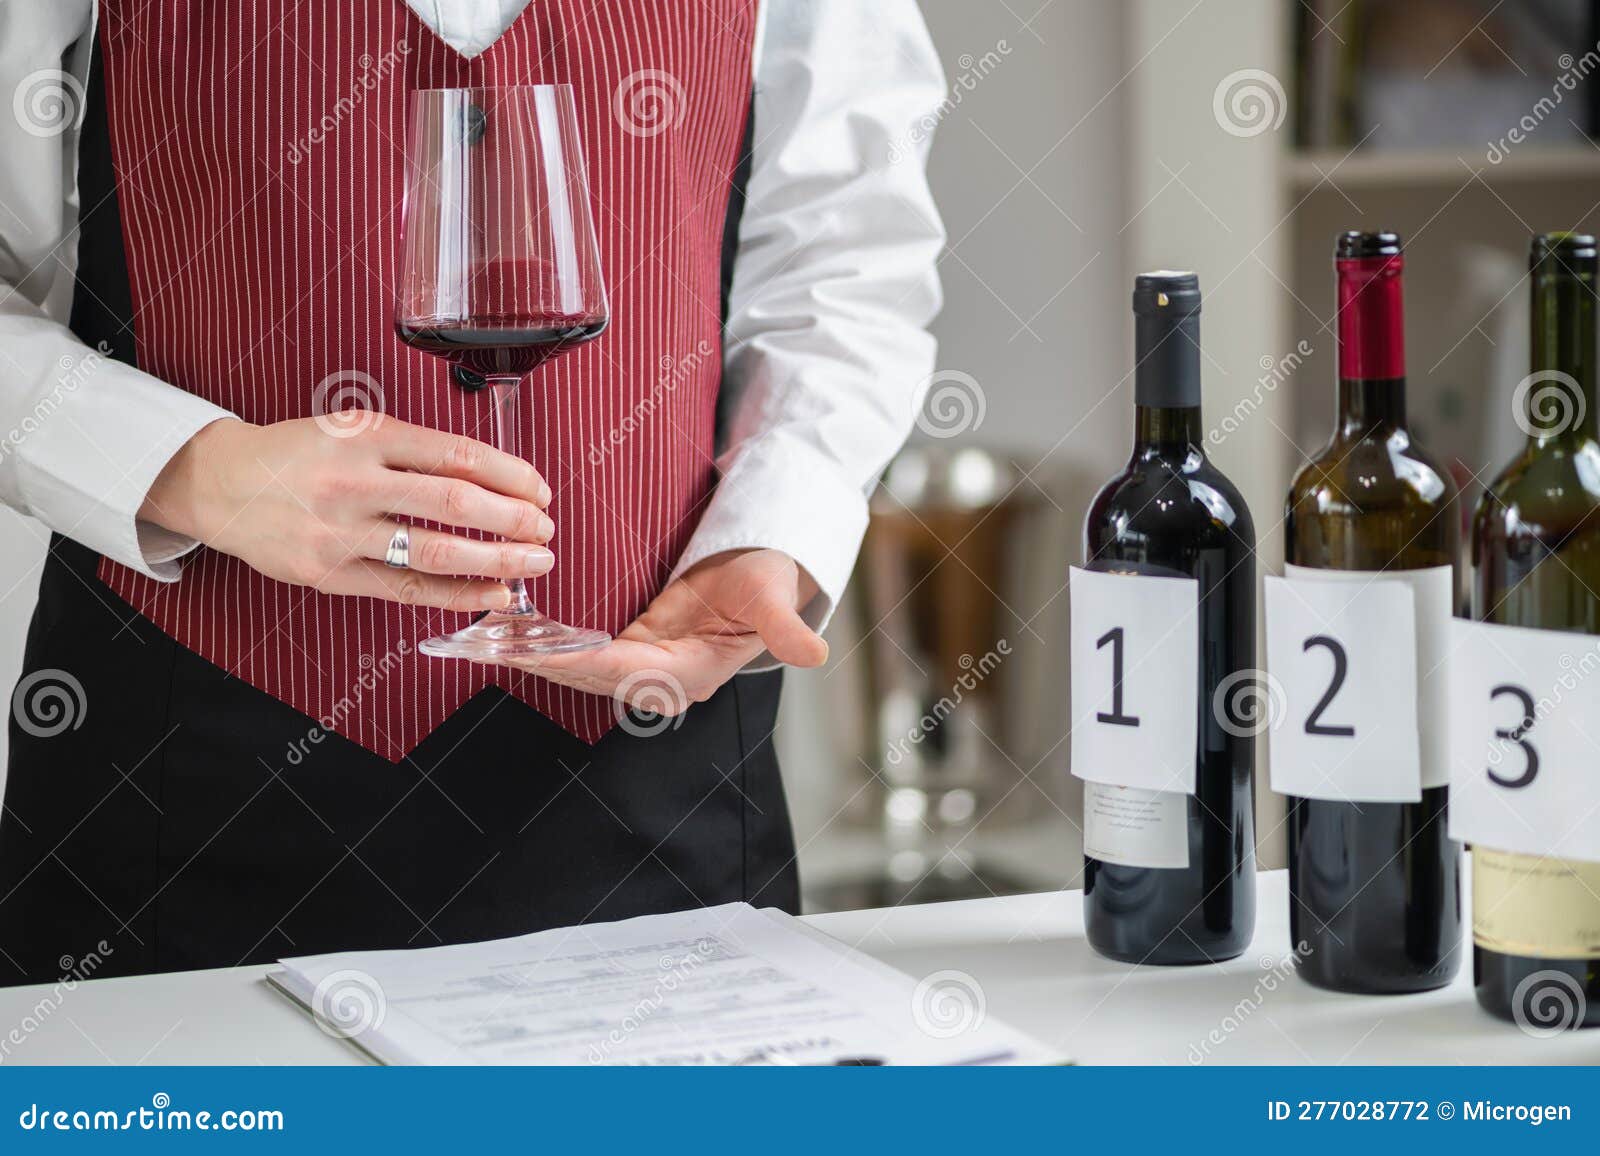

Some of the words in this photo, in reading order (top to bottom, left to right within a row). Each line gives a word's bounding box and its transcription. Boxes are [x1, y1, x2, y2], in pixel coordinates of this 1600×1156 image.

[1097, 626, 1140, 727] 1
[1303, 635, 1355, 737] 2
[1487, 685, 1539, 789] 3
